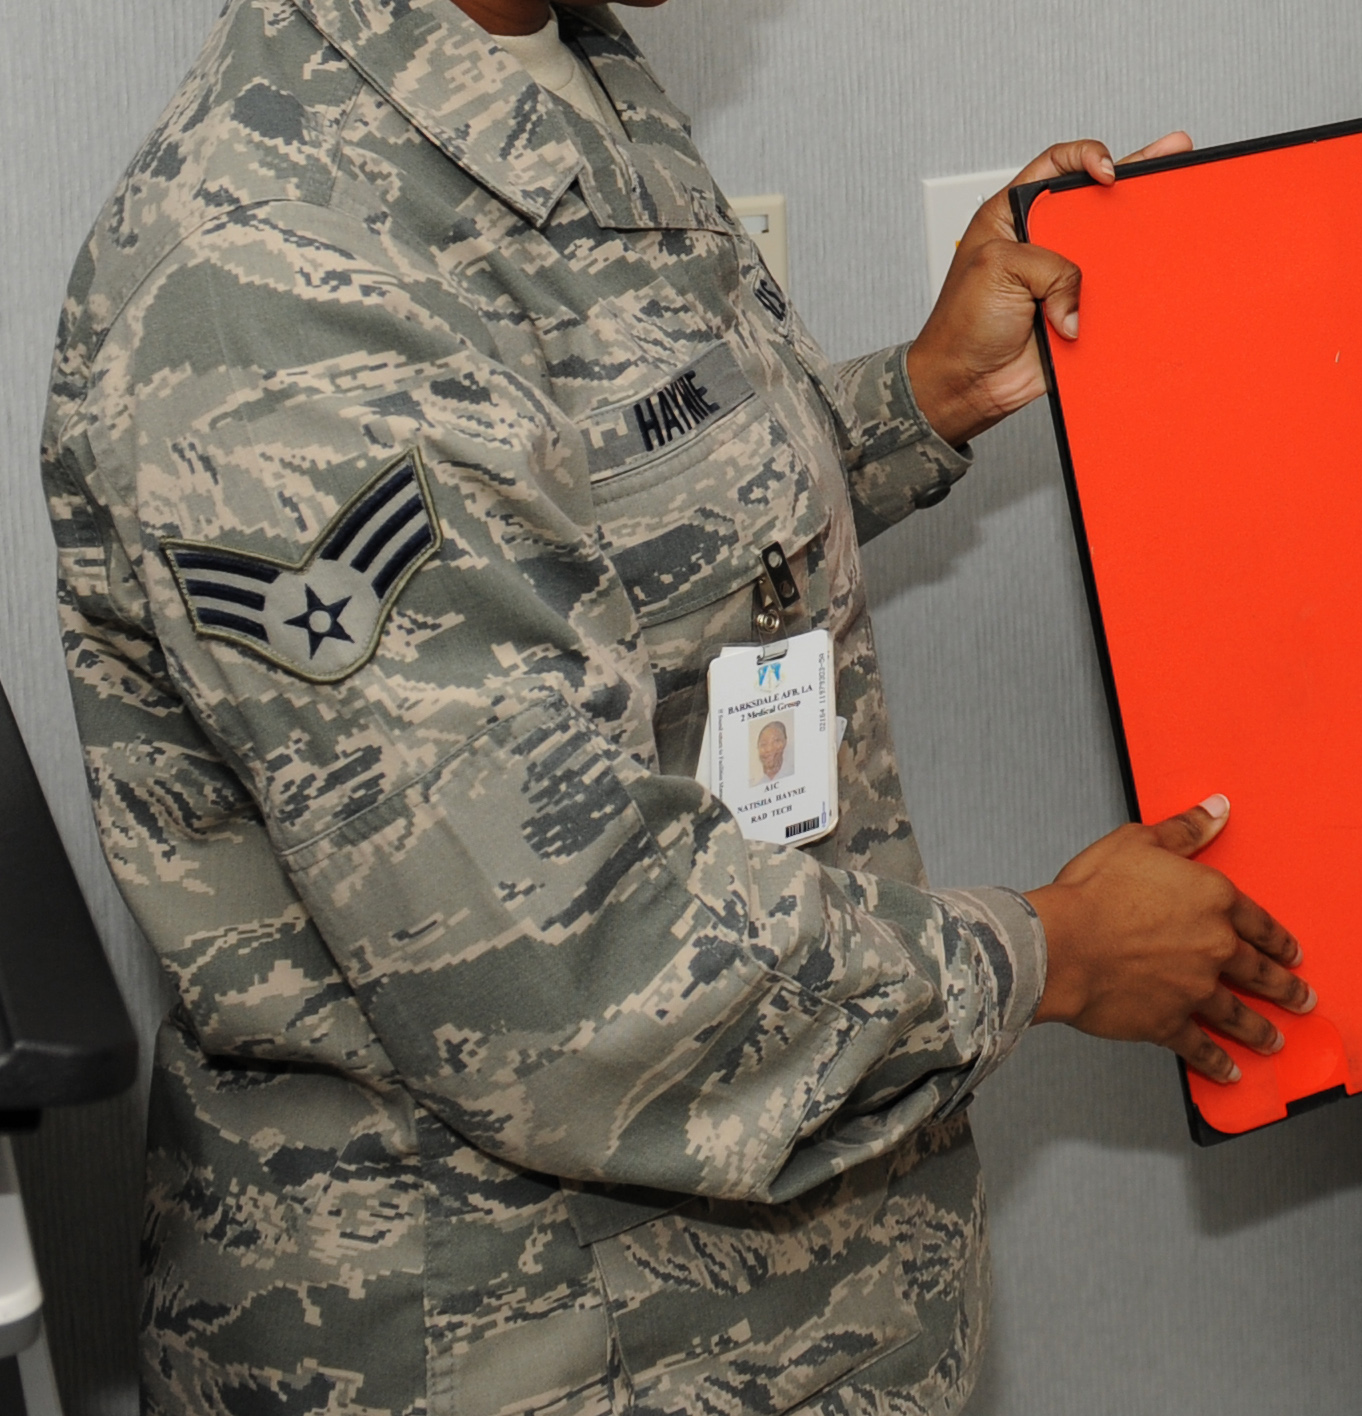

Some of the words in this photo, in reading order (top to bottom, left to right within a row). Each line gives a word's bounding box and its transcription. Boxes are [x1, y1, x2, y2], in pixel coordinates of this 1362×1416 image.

[633, 370, 720, 451] HAYNIE
[727, 693, 779, 715] BARKSDALE
[801, 684, 813, 694] LA
[740, 714, 745, 722] 2
[747, 705, 776, 720] Medical
[777, 699, 801, 711] Group
[737, 797, 772, 813] NATISHA
[775, 786, 806, 801] HAYNIE
[750, 812, 768, 824] RAD
[771, 804, 793, 817] TECH
